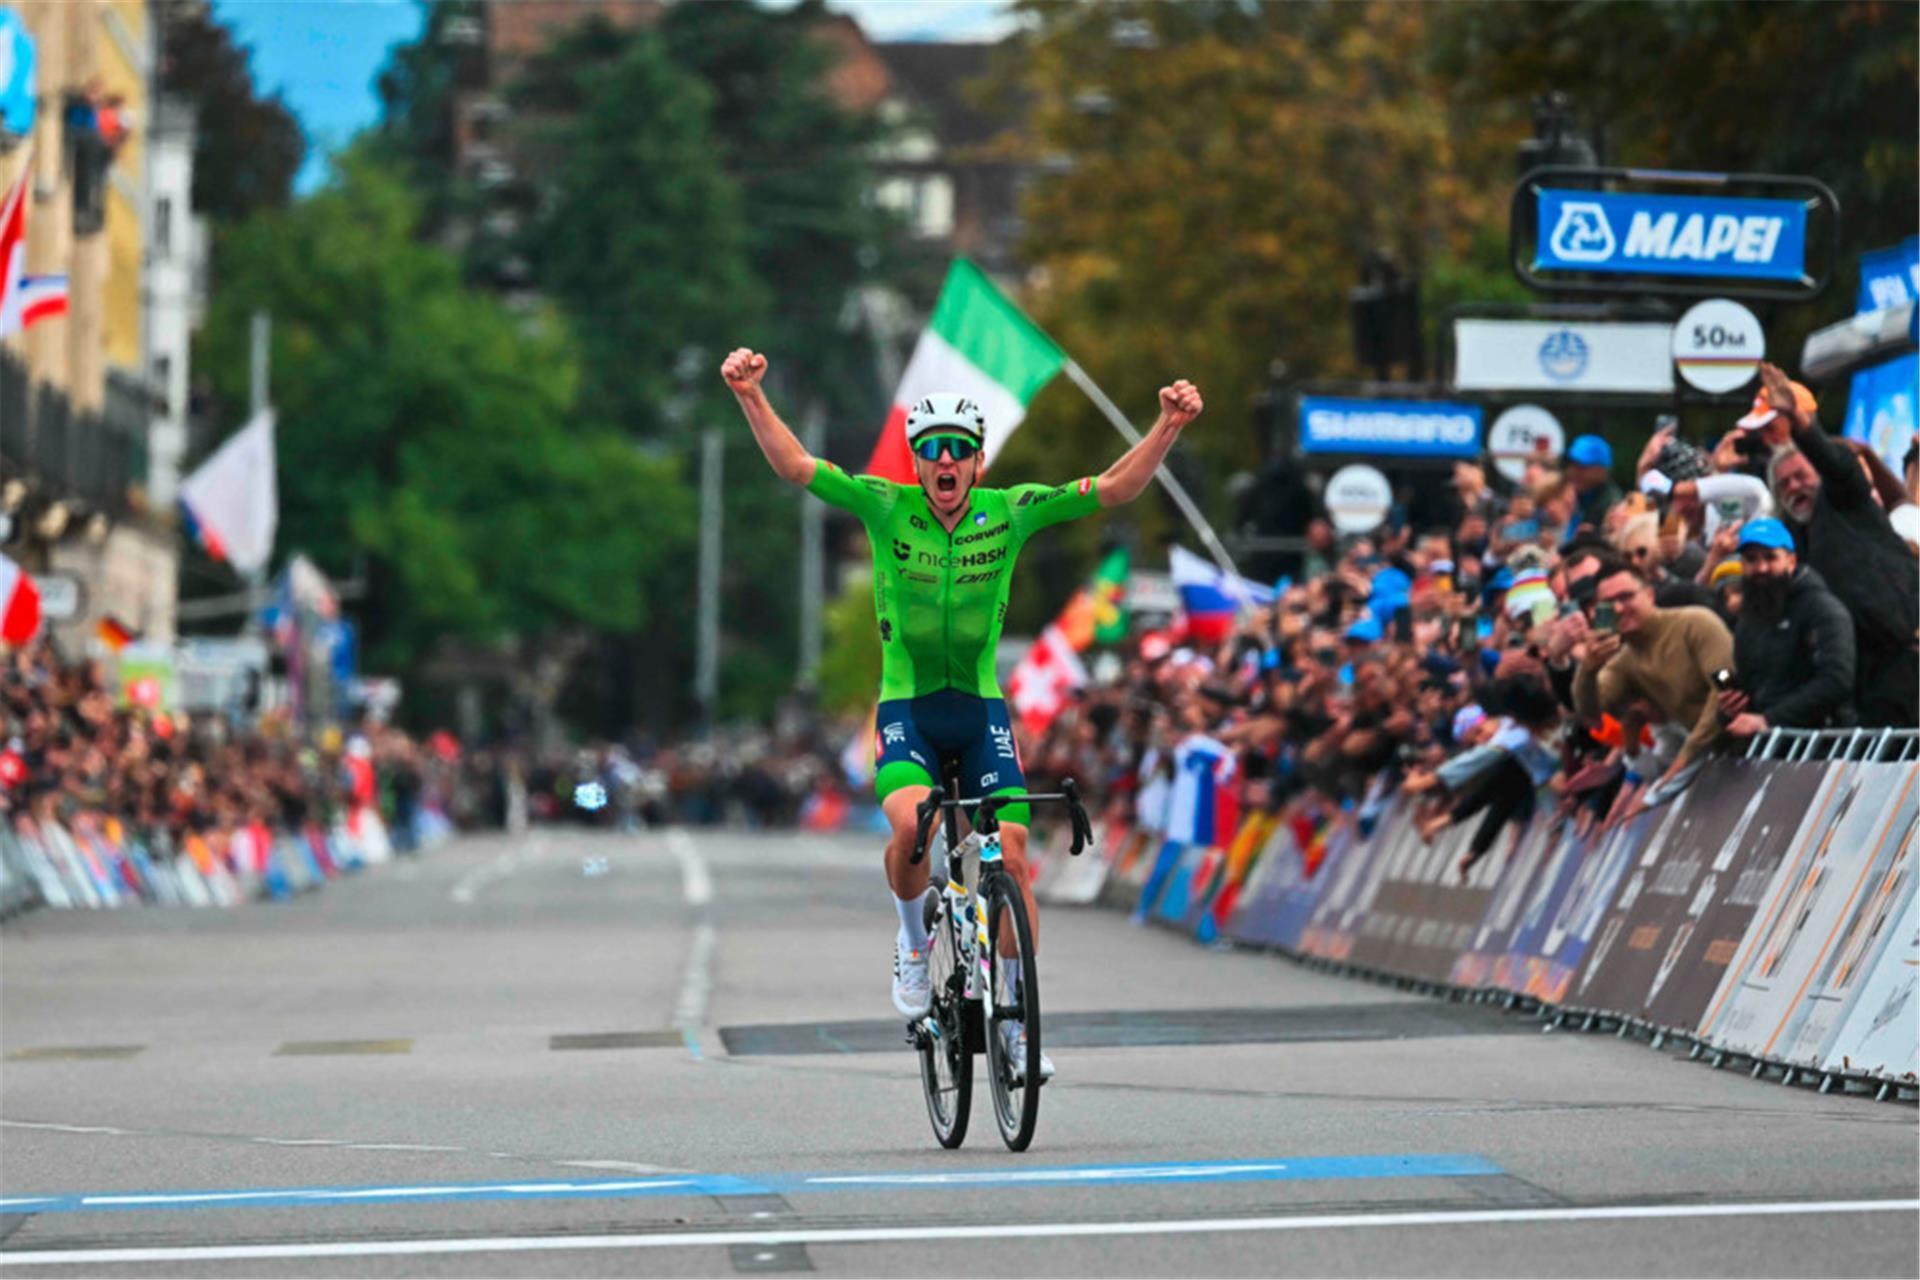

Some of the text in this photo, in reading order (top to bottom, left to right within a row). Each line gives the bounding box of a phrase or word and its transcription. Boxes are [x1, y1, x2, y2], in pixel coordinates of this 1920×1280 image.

[1622, 211, 1784, 264] MAPEI
[1692, 325, 1746, 349] 50M
[1307, 409, 1477, 445] SHIMANO
[954, 520, 1010, 546] CORWIN
[990, 724, 1015, 759] UAE
